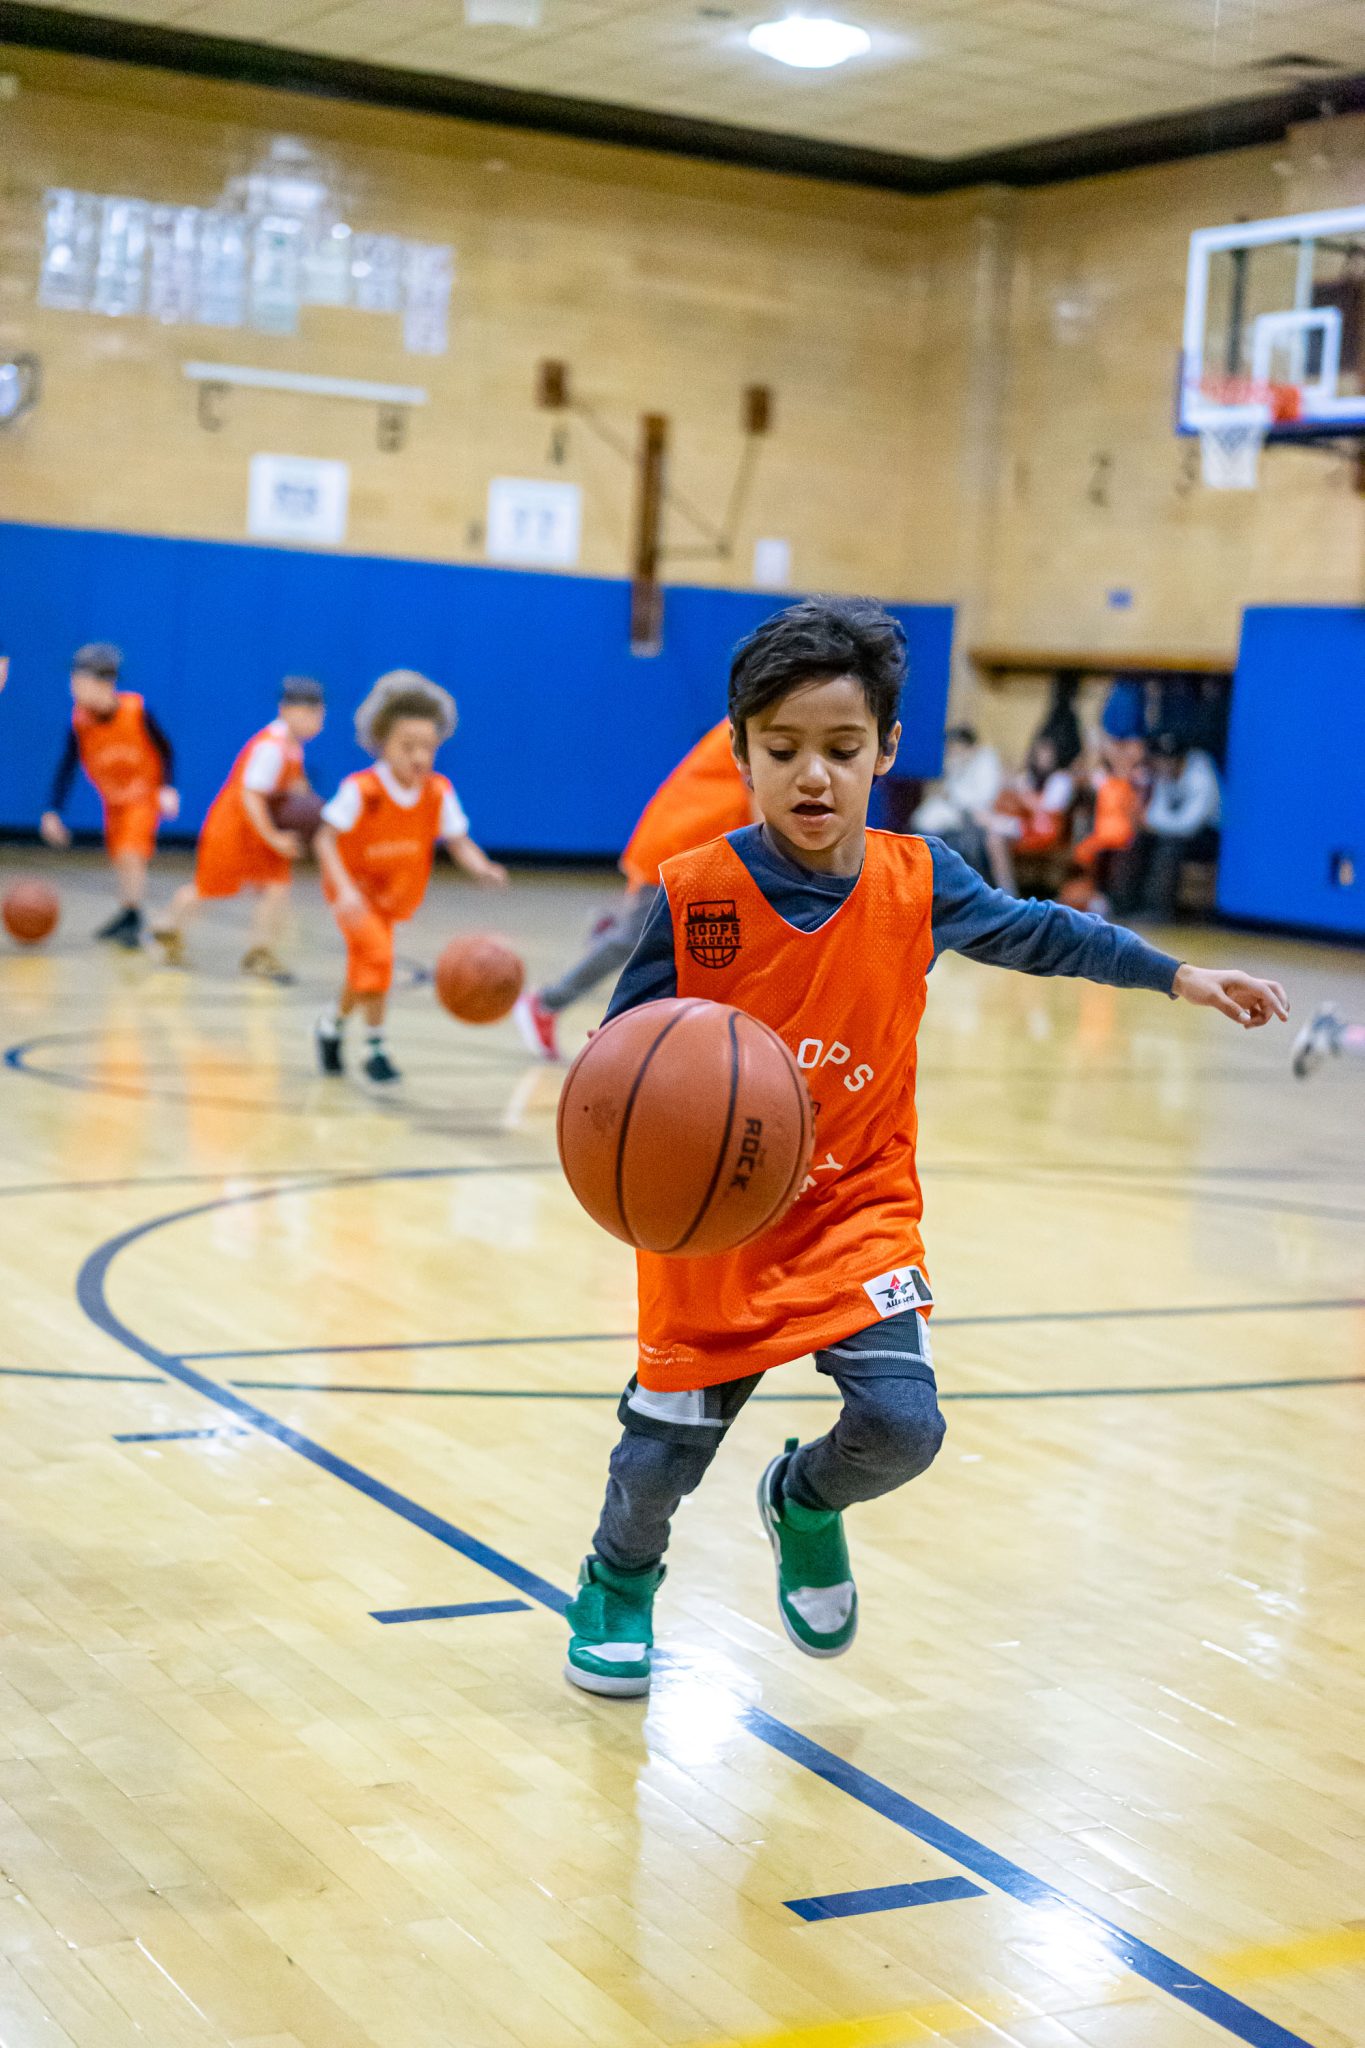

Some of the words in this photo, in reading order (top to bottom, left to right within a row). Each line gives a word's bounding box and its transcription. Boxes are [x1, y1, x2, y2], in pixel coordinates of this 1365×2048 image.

[687, 923, 740, 937] HOOPS
[687, 936, 740, 947] ACADEMY
[797, 1037, 874, 1092] OPS
[729, 1117, 763, 1192] ROCK
